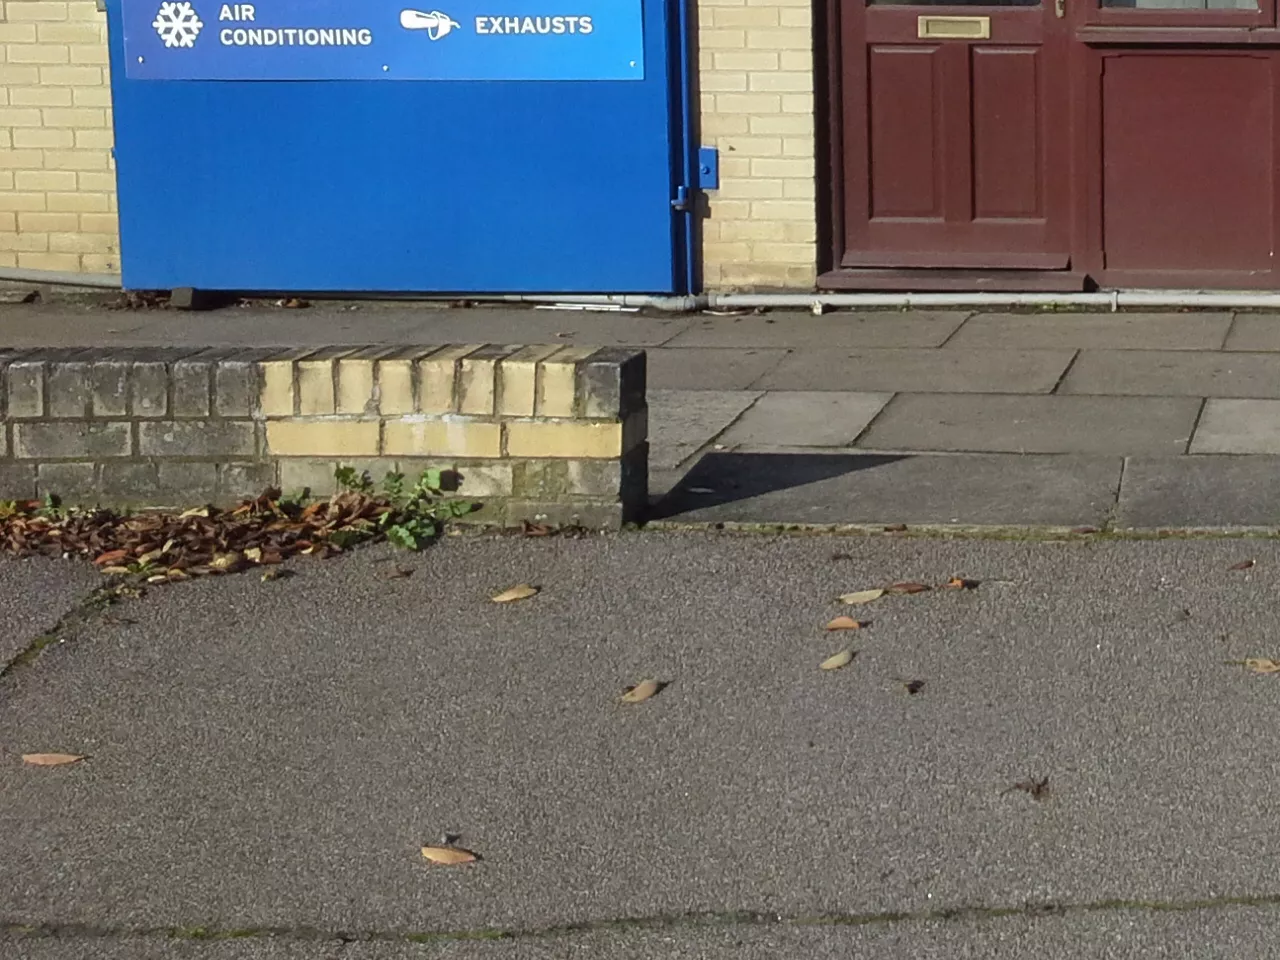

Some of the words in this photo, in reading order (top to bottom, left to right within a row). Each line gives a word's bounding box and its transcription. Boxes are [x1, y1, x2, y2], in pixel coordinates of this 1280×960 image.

[218, 5, 255, 22] AIR
[474, 15, 594, 35] EXHAUSTS
[219, 27, 372, 46] CONDITIONING
